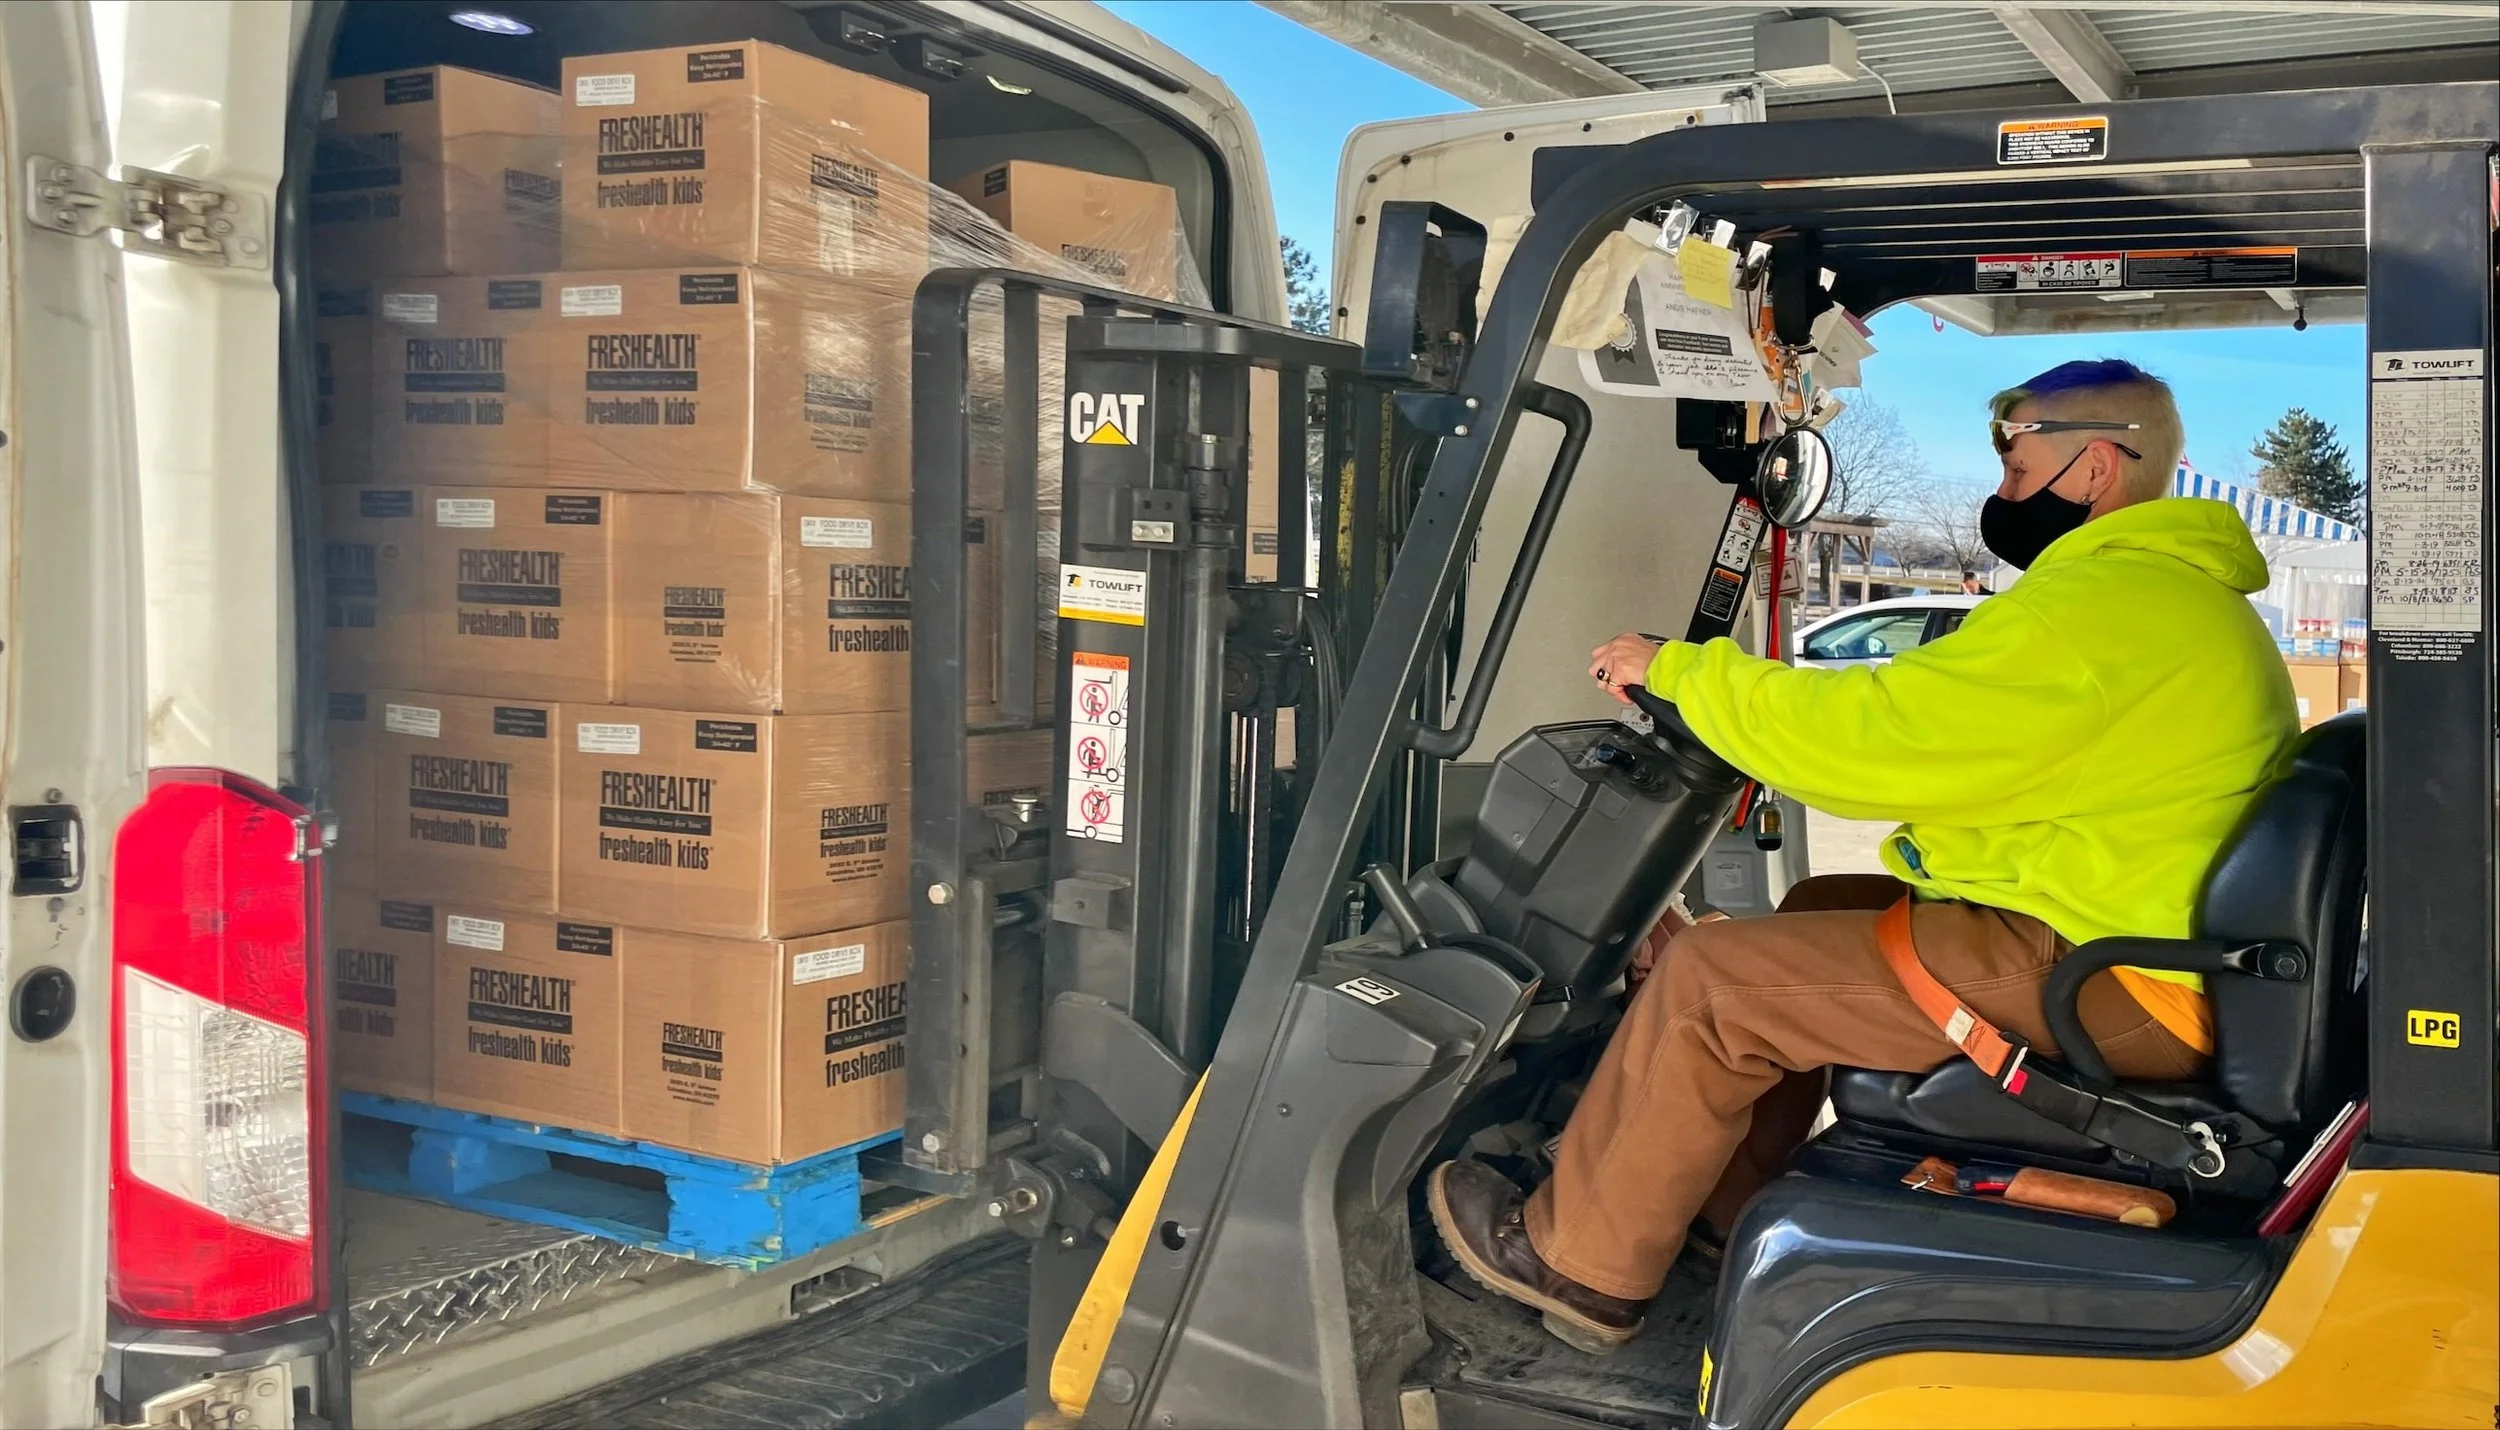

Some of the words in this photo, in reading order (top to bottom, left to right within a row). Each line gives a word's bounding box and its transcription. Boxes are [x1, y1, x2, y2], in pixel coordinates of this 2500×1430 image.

[599, 113, 703, 153] FRESHEALTH
[598, 178, 668, 208] freshealth
[673, 177, 703, 205] kids
[407, 338, 502, 371] FRESHEALTH
[588, 334, 696, 369] FRESHEALTH
[2413, 360, 2474, 368] TOWLIFT
[586, 397, 660, 425] freshealth
[664, 397, 697, 425] kids
[1070, 392, 1145, 445] CAT
[459, 549, 560, 585] FRESHEALTH
[1089, 580, 1143, 592] TOWLIFT
[2377, 596, 2394, 604] PM
[458, 608, 527, 638] freshealth
[531, 612, 561, 640] kids
[829, 624, 909, 652] freshealth
[1088, 659, 1127, 669] WARNING
[411, 754, 508, 796] FRESHEALTH
[602, 771, 710, 813] FRESHEALTH
[822, 803, 887, 828] FRESHEALTH
[480, 820, 508, 850] kids
[600, 832, 671, 867] freshealth
[677, 840, 709, 871] kids
[470, 966, 570, 1012] FRESHEALTH
[1345, 979, 1395, 1001] 19
[663, 1022, 722, 1050] FRESHEALTH
[2411, 1018, 2457, 1040] LPG
[469, 1025, 536, 1062] freshealth
[541, 1035, 571, 1068] kids
[825, 1041, 905, 1087] freshealth
